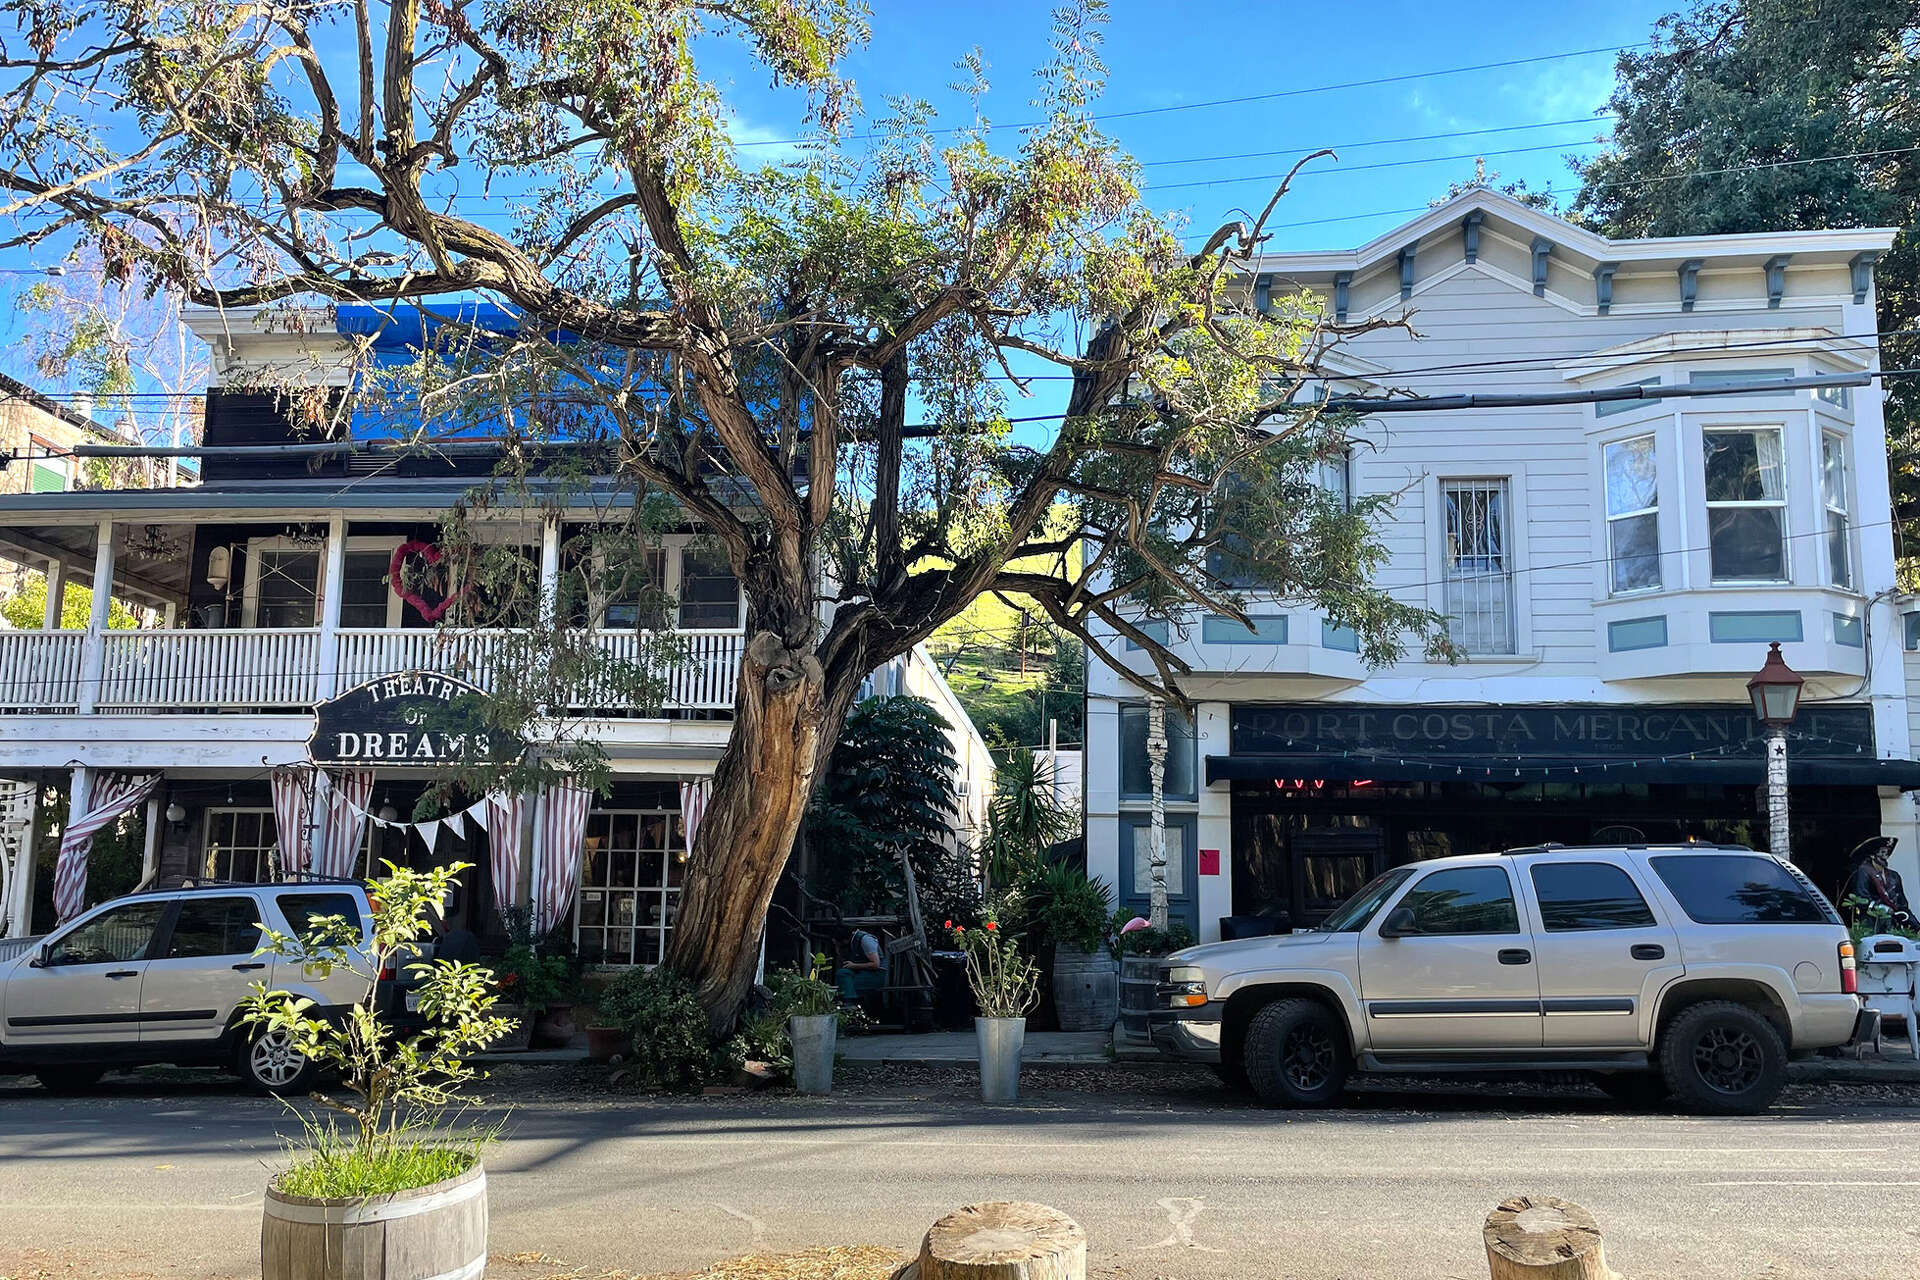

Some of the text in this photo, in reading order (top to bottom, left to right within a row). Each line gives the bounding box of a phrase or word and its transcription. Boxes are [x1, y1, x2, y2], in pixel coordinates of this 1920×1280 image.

[1252, 712, 1834, 741] PORT COSTA MERCANTE
[337, 732, 490, 758] DREAMS
